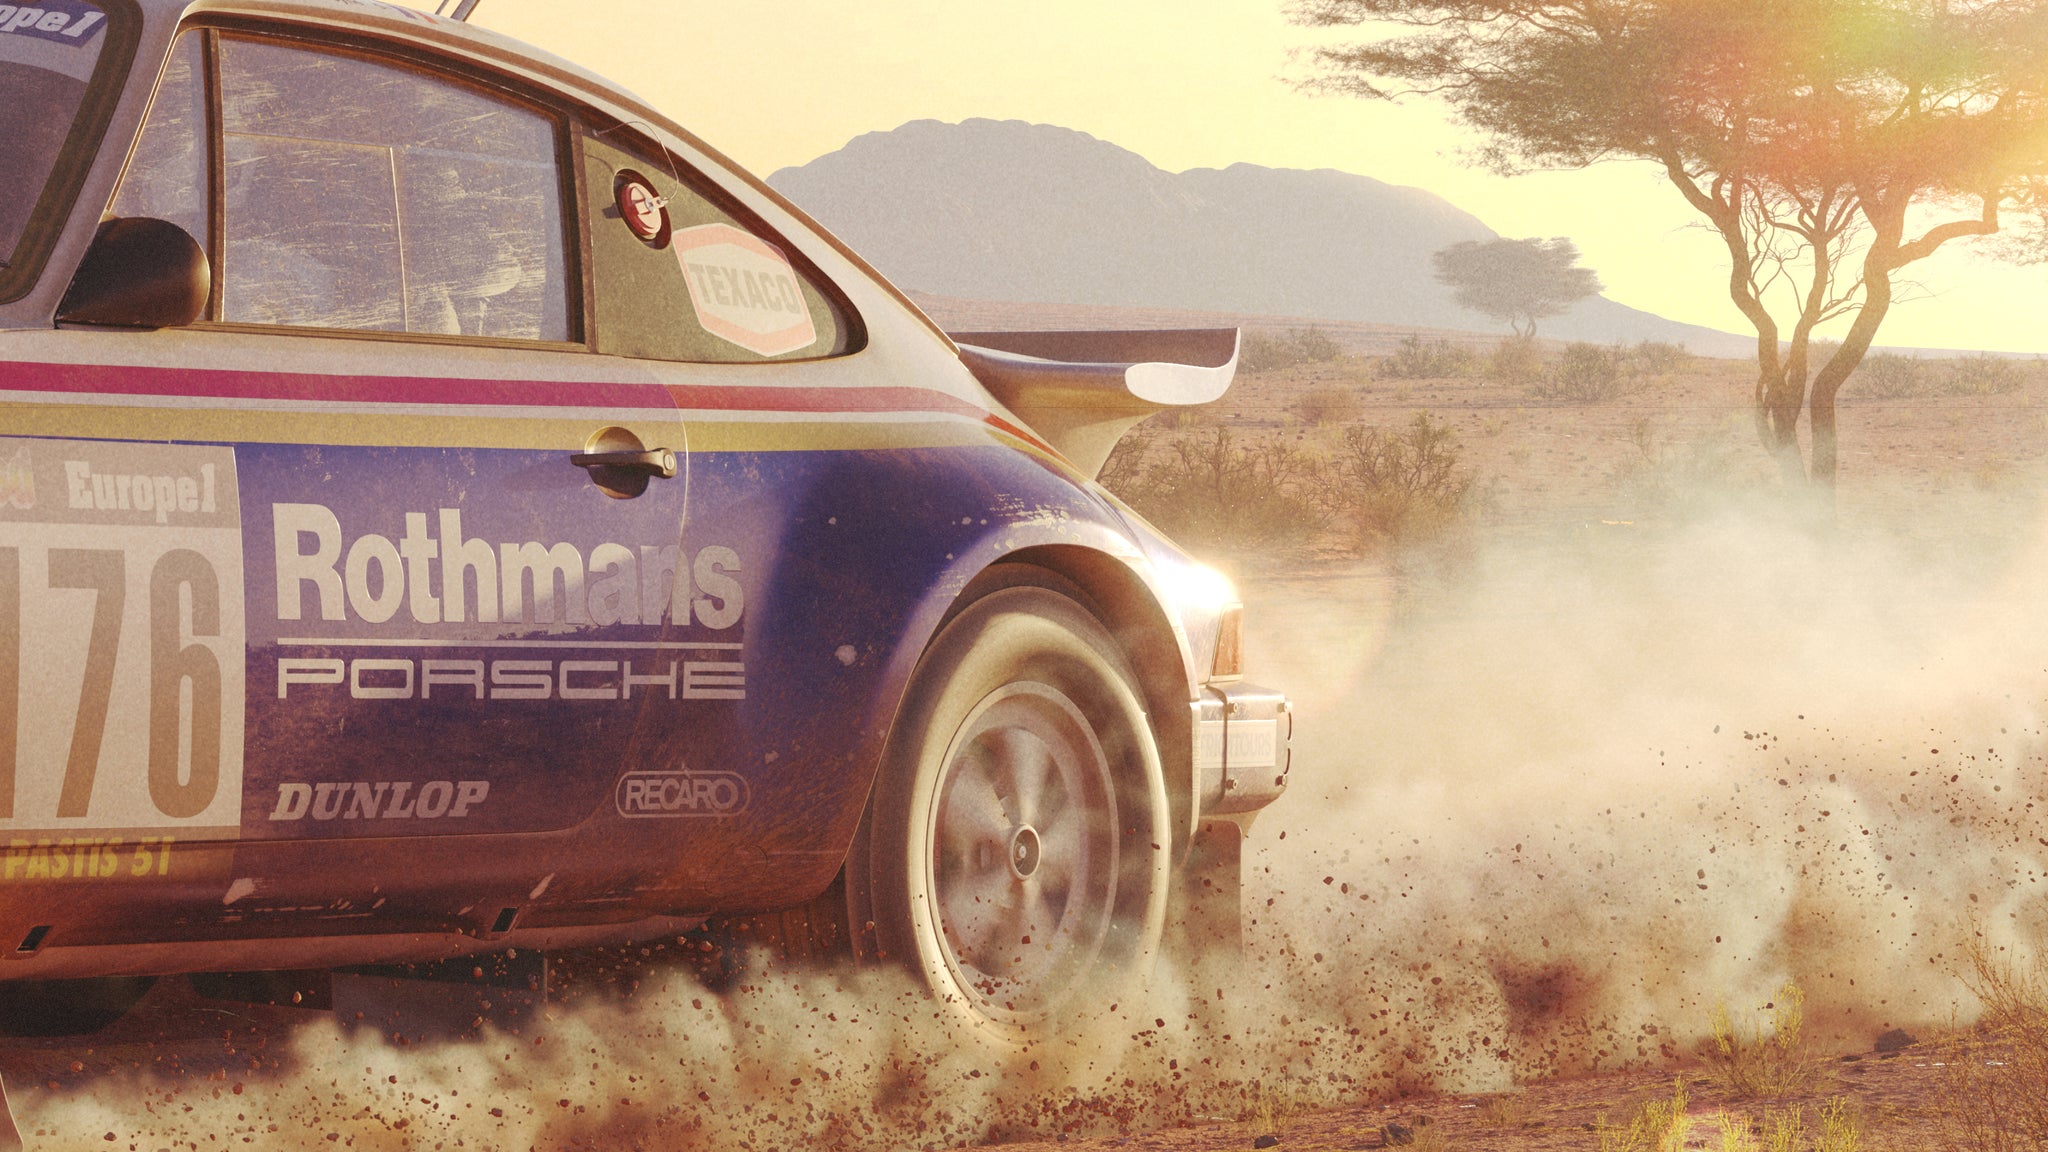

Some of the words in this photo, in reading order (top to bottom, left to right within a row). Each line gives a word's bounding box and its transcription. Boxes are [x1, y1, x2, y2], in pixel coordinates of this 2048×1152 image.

[687, 262, 801, 314] TEXACO
[272, 502, 745, 631] Rothmans
[277, 658, 746, 700] PORSCHE
[268, 780, 490, 821] DUNLOP
[625, 778, 739, 810] RECARO
[4, 837, 123, 880] PASTIS
[131, 835, 175, 877] 51
